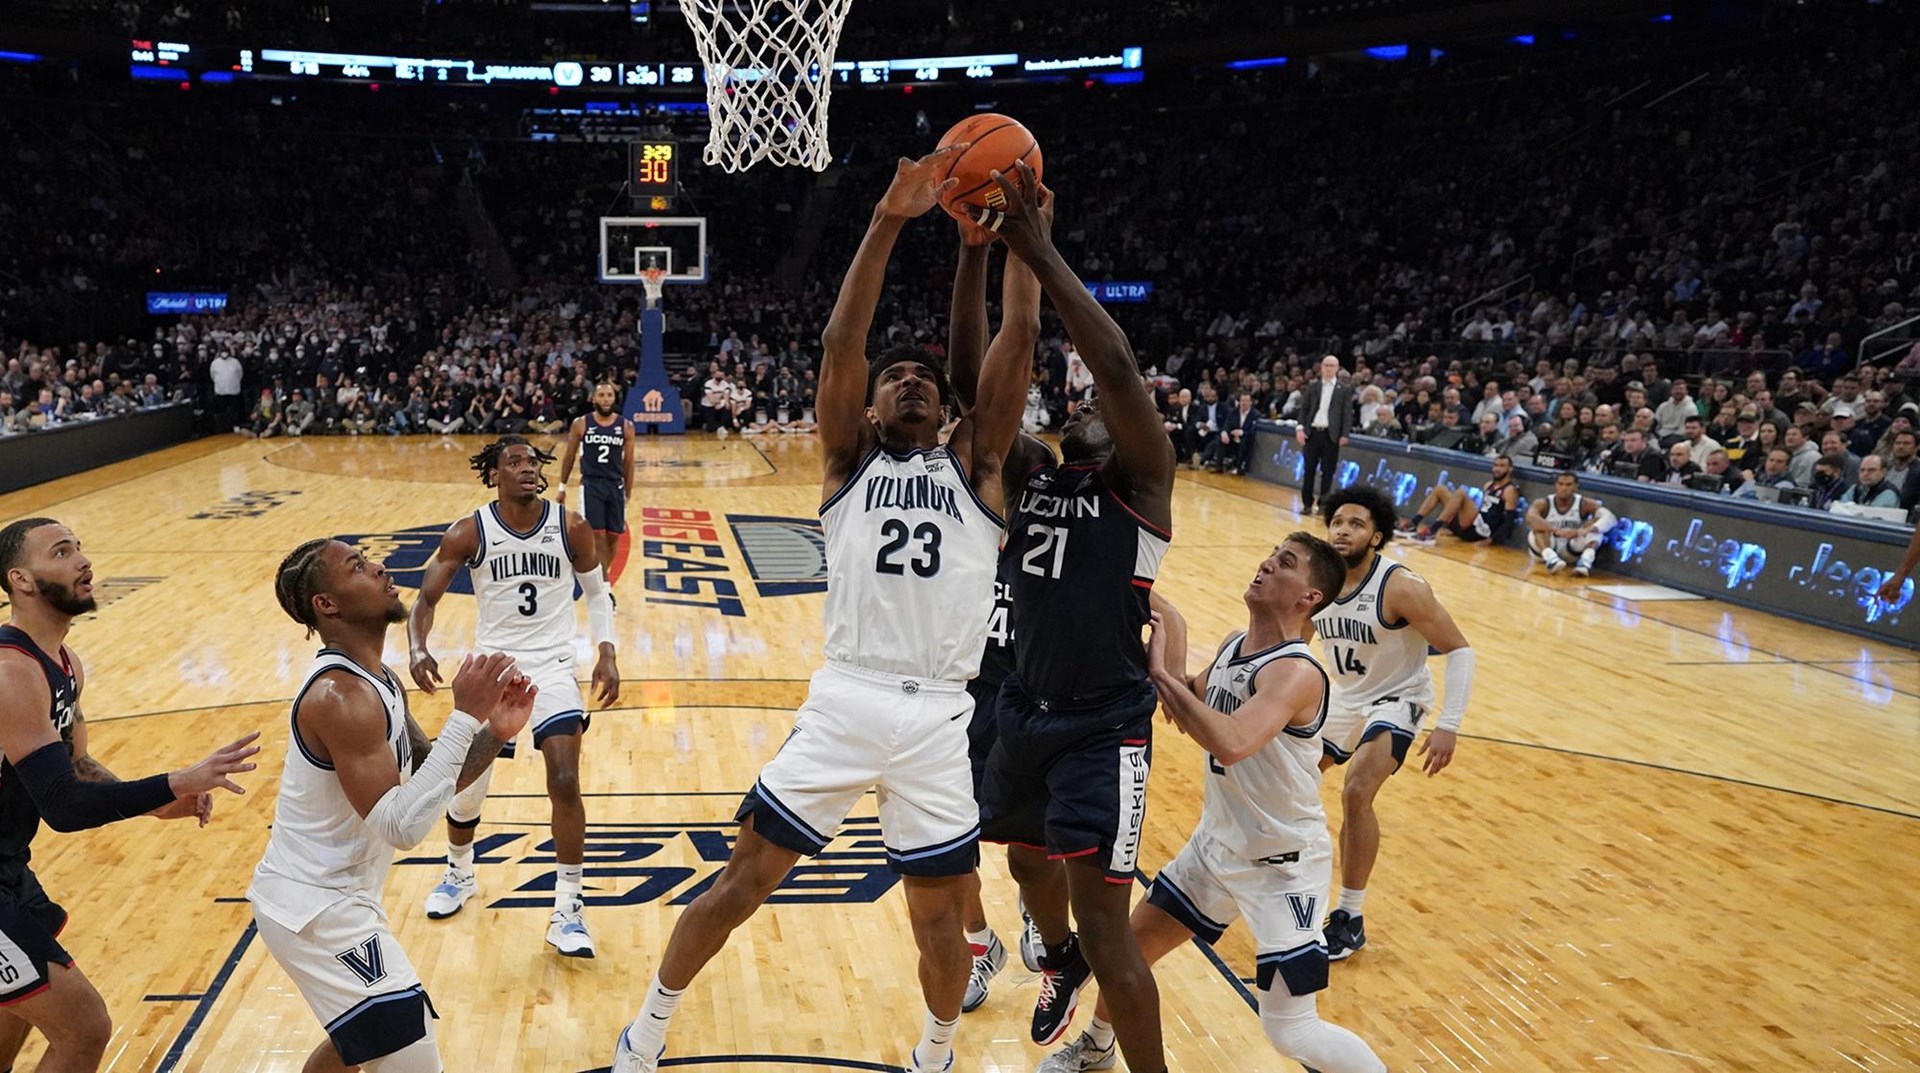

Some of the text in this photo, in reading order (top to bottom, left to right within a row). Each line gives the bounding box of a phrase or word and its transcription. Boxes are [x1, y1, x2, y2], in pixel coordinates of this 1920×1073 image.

[590, 66, 612, 82] 30
[671, 67, 694, 82] 25
[643, 144, 672, 161] 3:29
[640, 159, 668, 183] 30
[1105, 285, 1147, 298] ULTRA
[585, 434, 624, 446] UCONN
[597, 445, 610, 463] 2
[865, 474, 965, 526] VILLANOVA
[1366, 458, 1417, 507] Jeep
[1019, 490, 1100, 518] UCONN
[642, 507, 719, 542] BIG
[876, 518, 942, 578] 23
[1022, 523, 1069, 580] 21
[1666, 518, 1767, 590] Jeep
[489, 552, 561, 582] VILLANOVA
[642, 540, 747, 618] EAST
[518, 582, 538, 617] 3
[1333, 645, 1367, 676] 14
[1123, 751, 1146, 867] HUSKIES
[1285, 892, 1318, 932] V
[335, 932, 388, 988] V
